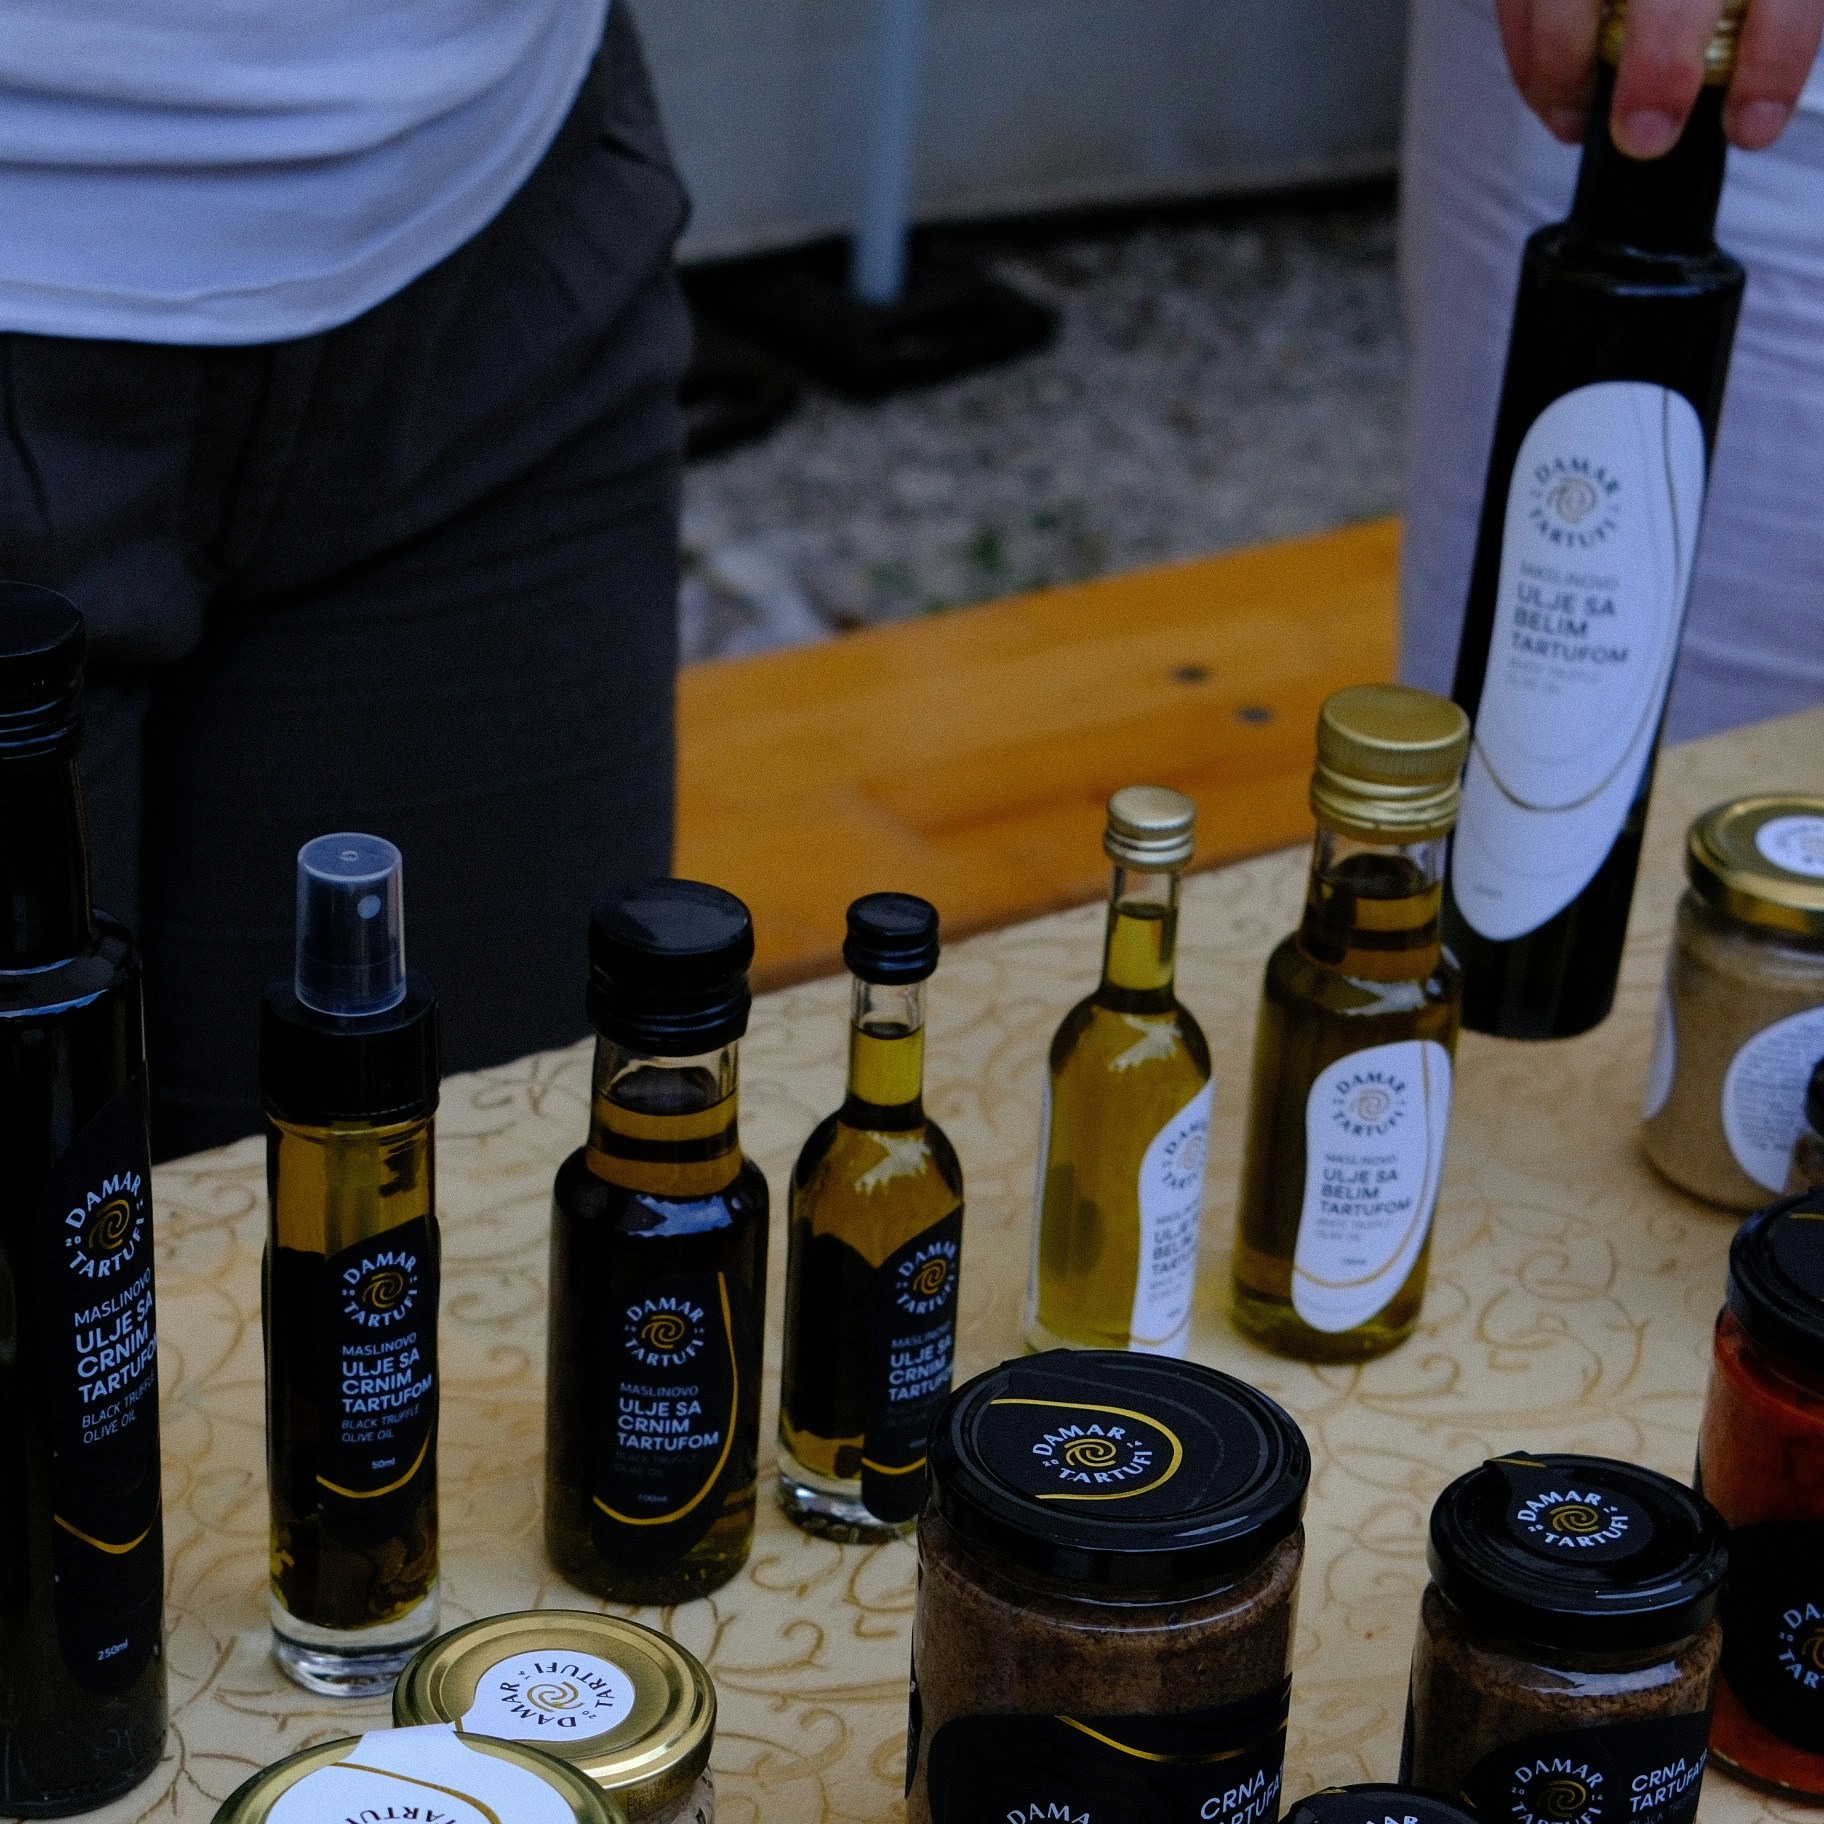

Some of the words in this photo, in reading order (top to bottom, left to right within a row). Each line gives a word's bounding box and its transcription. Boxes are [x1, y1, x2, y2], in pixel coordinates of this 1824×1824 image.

[1535, 456, 1622, 498] DAMAR
[1529, 508, 1619, 548] TARTUFI
[1518, 582, 1576, 612] ULJE
[1585, 593, 1616, 617] SA
[1514, 605, 1588, 638] BELIM
[1510, 632, 1630, 666] TARTUFOM
[1321, 1184, 1379, 1200] BELIM
[1324, 1168, 1371, 1184] ULJE
[65, 1171, 142, 1229] DAMAR
[69, 1217, 145, 1278] TARTUFI
[342, 1250, 417, 1285] DAMAR
[74, 1267, 152, 1328] MASLINOVO
[342, 1289, 418, 1328] TARTUFI
[626, 1296, 705, 1322] DAMAR
[76, 1310, 133, 1354] ULJE
[137, 1290, 154, 1316] SA
[77, 1319, 150, 1380] CRNIM
[342, 1331, 418, 1357] MASLINOVO
[624, 1337, 705, 1367] TARTUFI
[890, 1340, 933, 1369] ULJE
[342, 1354, 395, 1378] ULJE
[399, 1347, 421, 1368] SA
[342, 1368, 413, 1396] CRNIM
[342, 1373, 433, 1414] TARTUFOM
[82, 1398, 122, 1429] BLACK
[616, 1414, 690, 1434] CRNIM
[619, 1397, 672, 1417] ULJE
[676, 1398, 702, 1416] SA
[83, 1418, 119, 1444] OLIVE
[616, 1430, 719, 1452] TARTUFOM
[1031, 1421, 1127, 1458] DAMAR
[1057, 1448, 1154, 1486] TARTUFI
[1515, 1489, 1603, 1527] DAMAR
[1543, 1508, 1632, 1549] TARTUFI
[532, 1661, 614, 1709] TARTUFI
[500, 1681, 578, 1729] DAMAR
[1510, 1758, 1606, 1788] DAMAR
[1631, 1757, 1687, 1793] CRNA
[1200, 1769, 1266, 1820] CRNA
